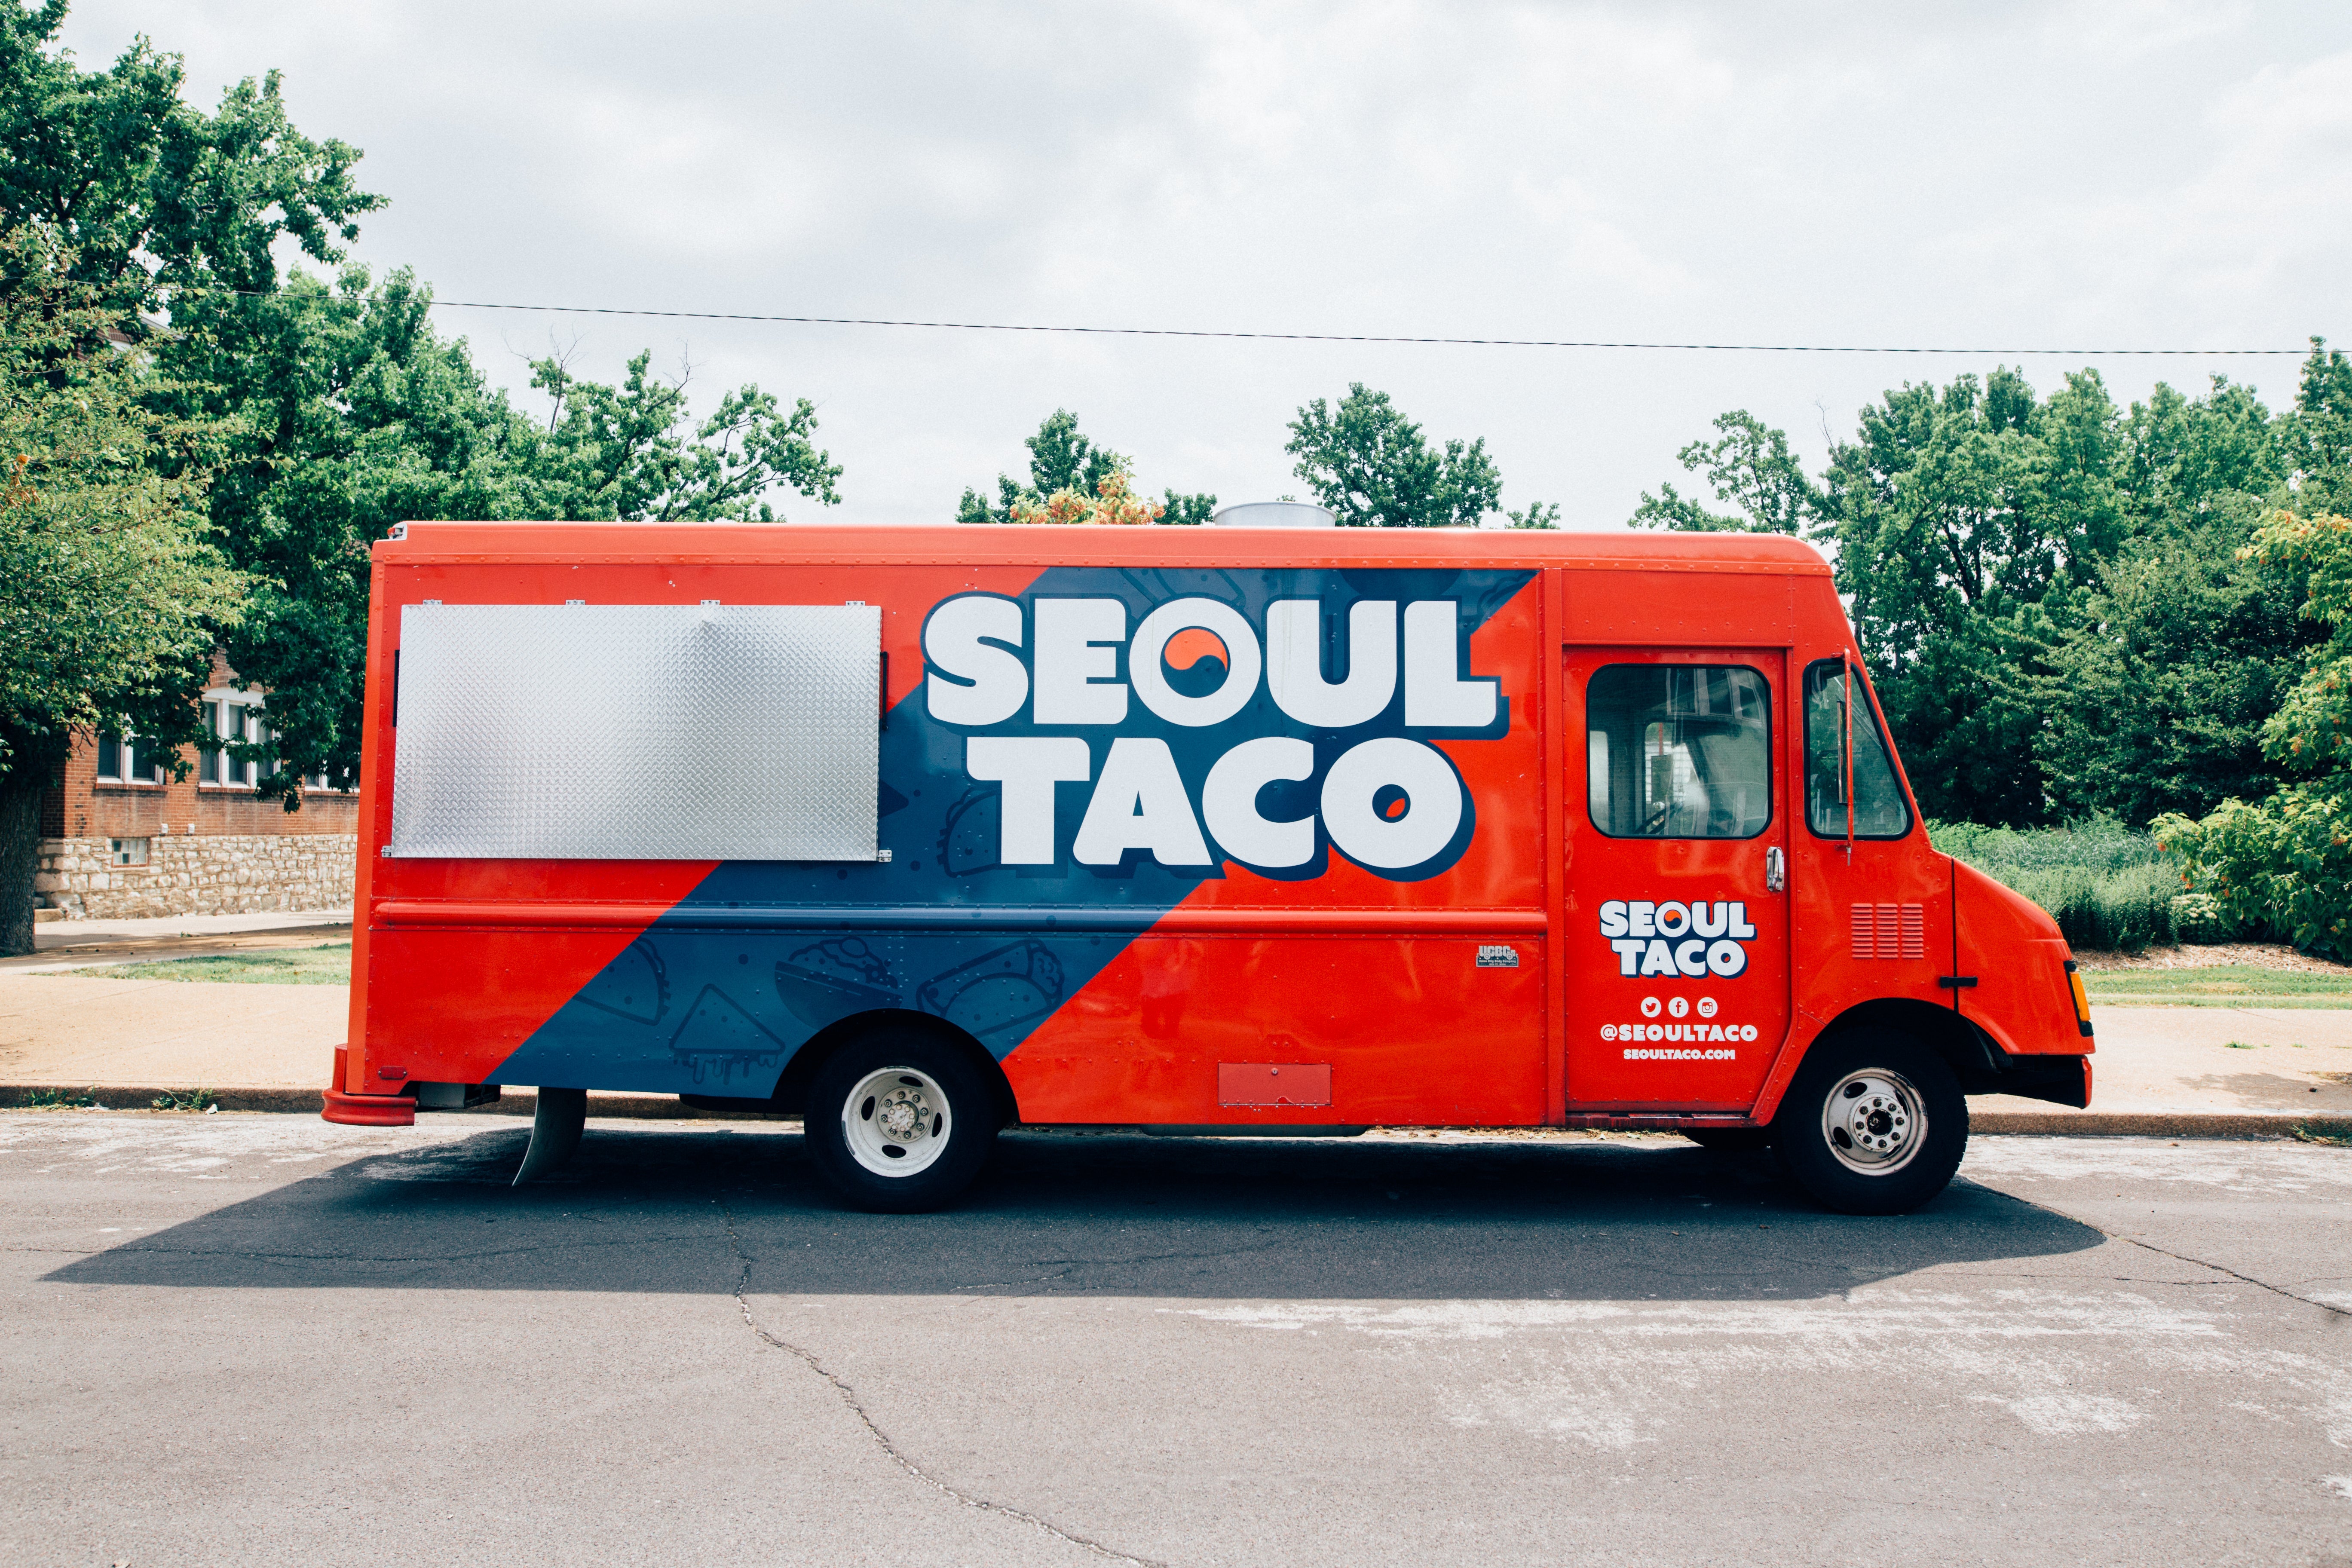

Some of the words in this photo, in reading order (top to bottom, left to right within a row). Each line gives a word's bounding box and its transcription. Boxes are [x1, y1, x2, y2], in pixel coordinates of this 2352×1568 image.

[925, 596, 1496, 728] SEOUL
[967, 737, 1462, 868] TACO
[1600, 900, 1755, 938] SEOUL
[1611, 939, 1745, 976] TACO
[1600, 1024, 1758, 1041] @SEOULTACO
[1623, 1049, 1735, 1060] SEOULTACO.COM
